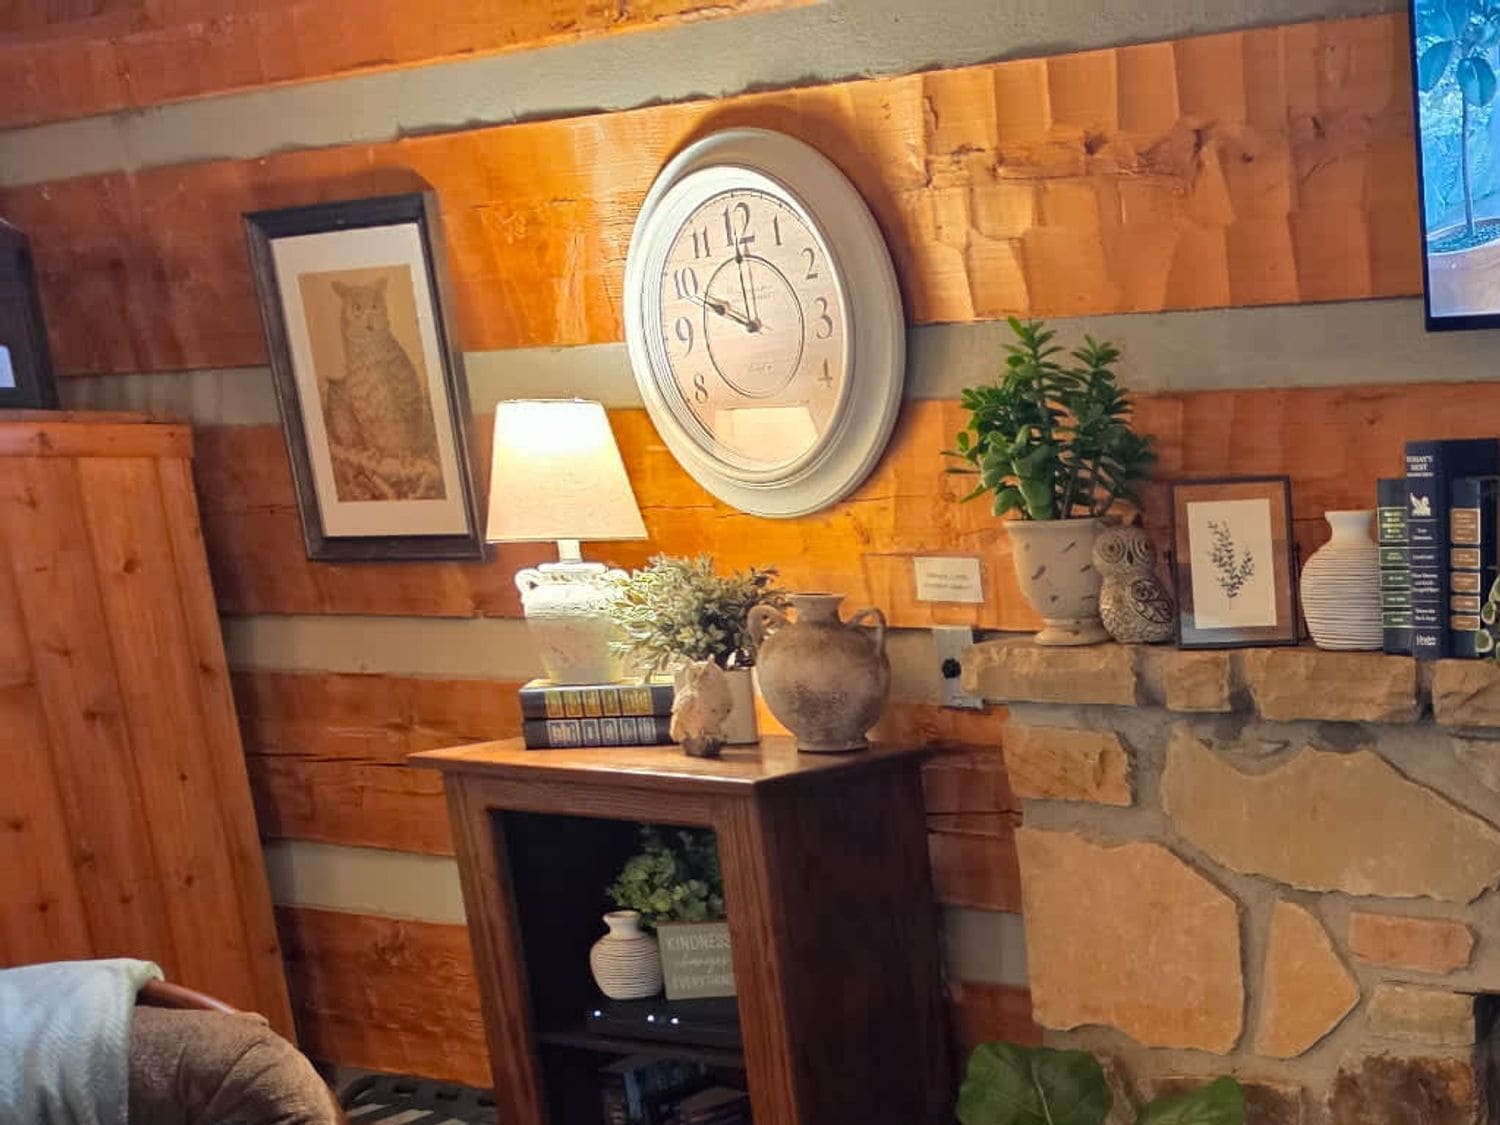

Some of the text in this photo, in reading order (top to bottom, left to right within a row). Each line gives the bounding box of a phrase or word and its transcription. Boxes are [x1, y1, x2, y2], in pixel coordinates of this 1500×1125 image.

[722, 202, 755, 247] 12
[772, 212, 783, 247] 1
[692, 225, 712, 259] 11
[801, 247, 819, 280] 2
[673, 267, 699, 300] 10
[814, 296, 834, 340] 3
[675, 316, 695, 360] 9
[693, 373, 709, 405] 8
[817, 357, 834, 389] 4
